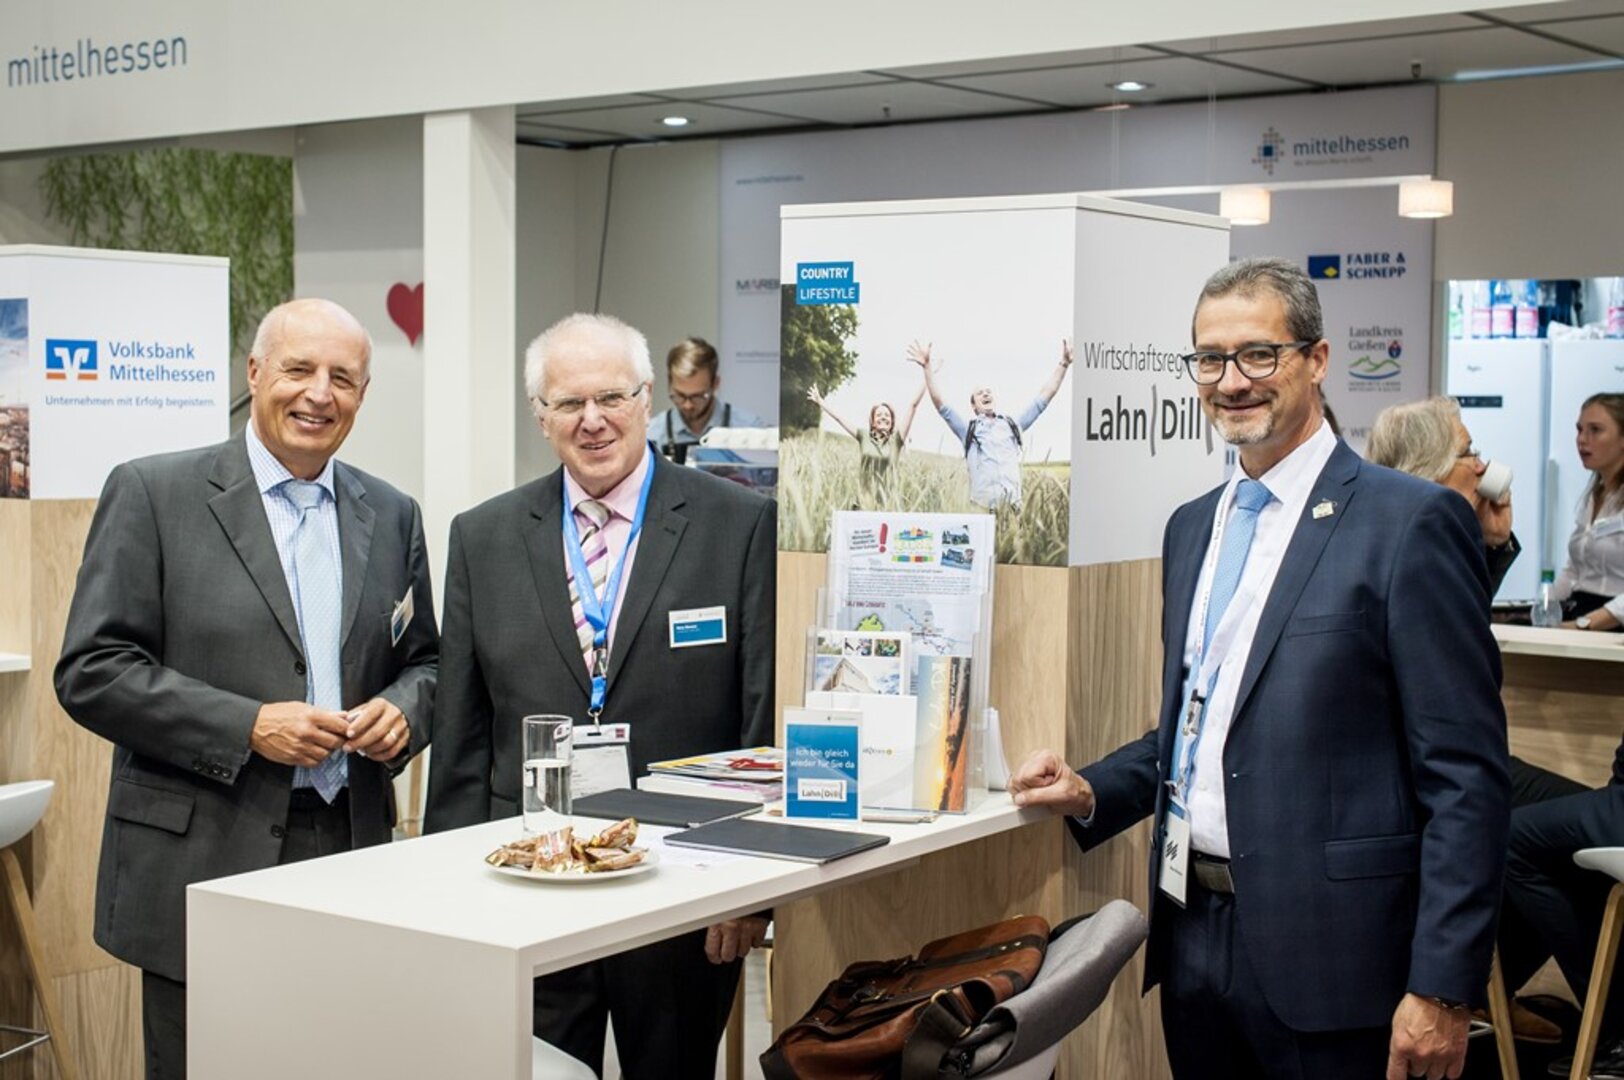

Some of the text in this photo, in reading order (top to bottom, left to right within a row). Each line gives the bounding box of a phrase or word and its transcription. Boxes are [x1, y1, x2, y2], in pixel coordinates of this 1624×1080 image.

[8, 36, 188, 87] mittelhessen
[1293, 135, 1410, 156] mittelhessen
[1346, 251, 1406, 264] FABER &
[800, 267, 850, 280] COUNTRY
[1346, 266, 1406, 279] SCHNEPP
[800, 287, 856, 300] LIFESTYLE
[1349, 325, 1403, 338] Landkreis
[109, 340, 196, 360] Volksbank
[109, 363, 216, 383] Mittelhessen
[45, 395, 115, 406] Unternehmen
[116, 396, 133, 406] mit
[135, 396, 164, 409] Erfolg
[824, 749, 849, 759] gleich
[790, 758, 816, 768] wieder
[845, 761, 856, 769] da
